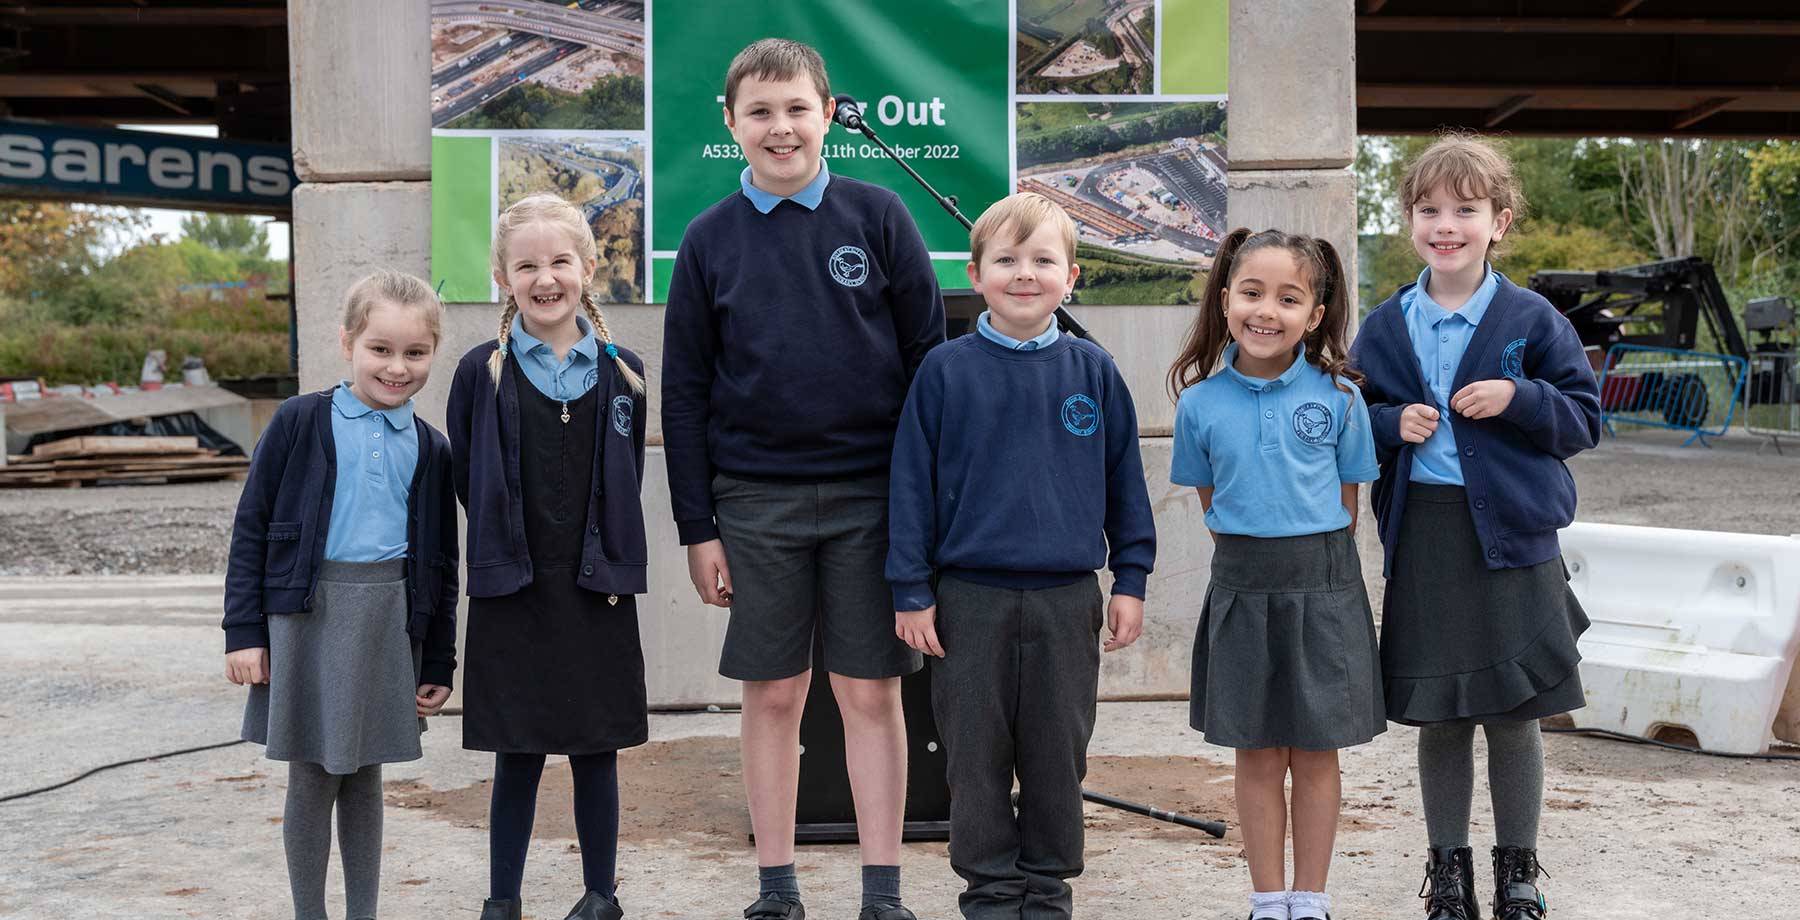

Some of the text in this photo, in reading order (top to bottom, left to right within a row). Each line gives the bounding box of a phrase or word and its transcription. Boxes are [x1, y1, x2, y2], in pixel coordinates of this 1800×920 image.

[877, 95, 946, 126] Out
[0, 134, 291, 196] sarens
[702, 144, 744, 160] A533,
[823, 144, 856, 159] 11th
[924, 144, 960, 159] 2022
